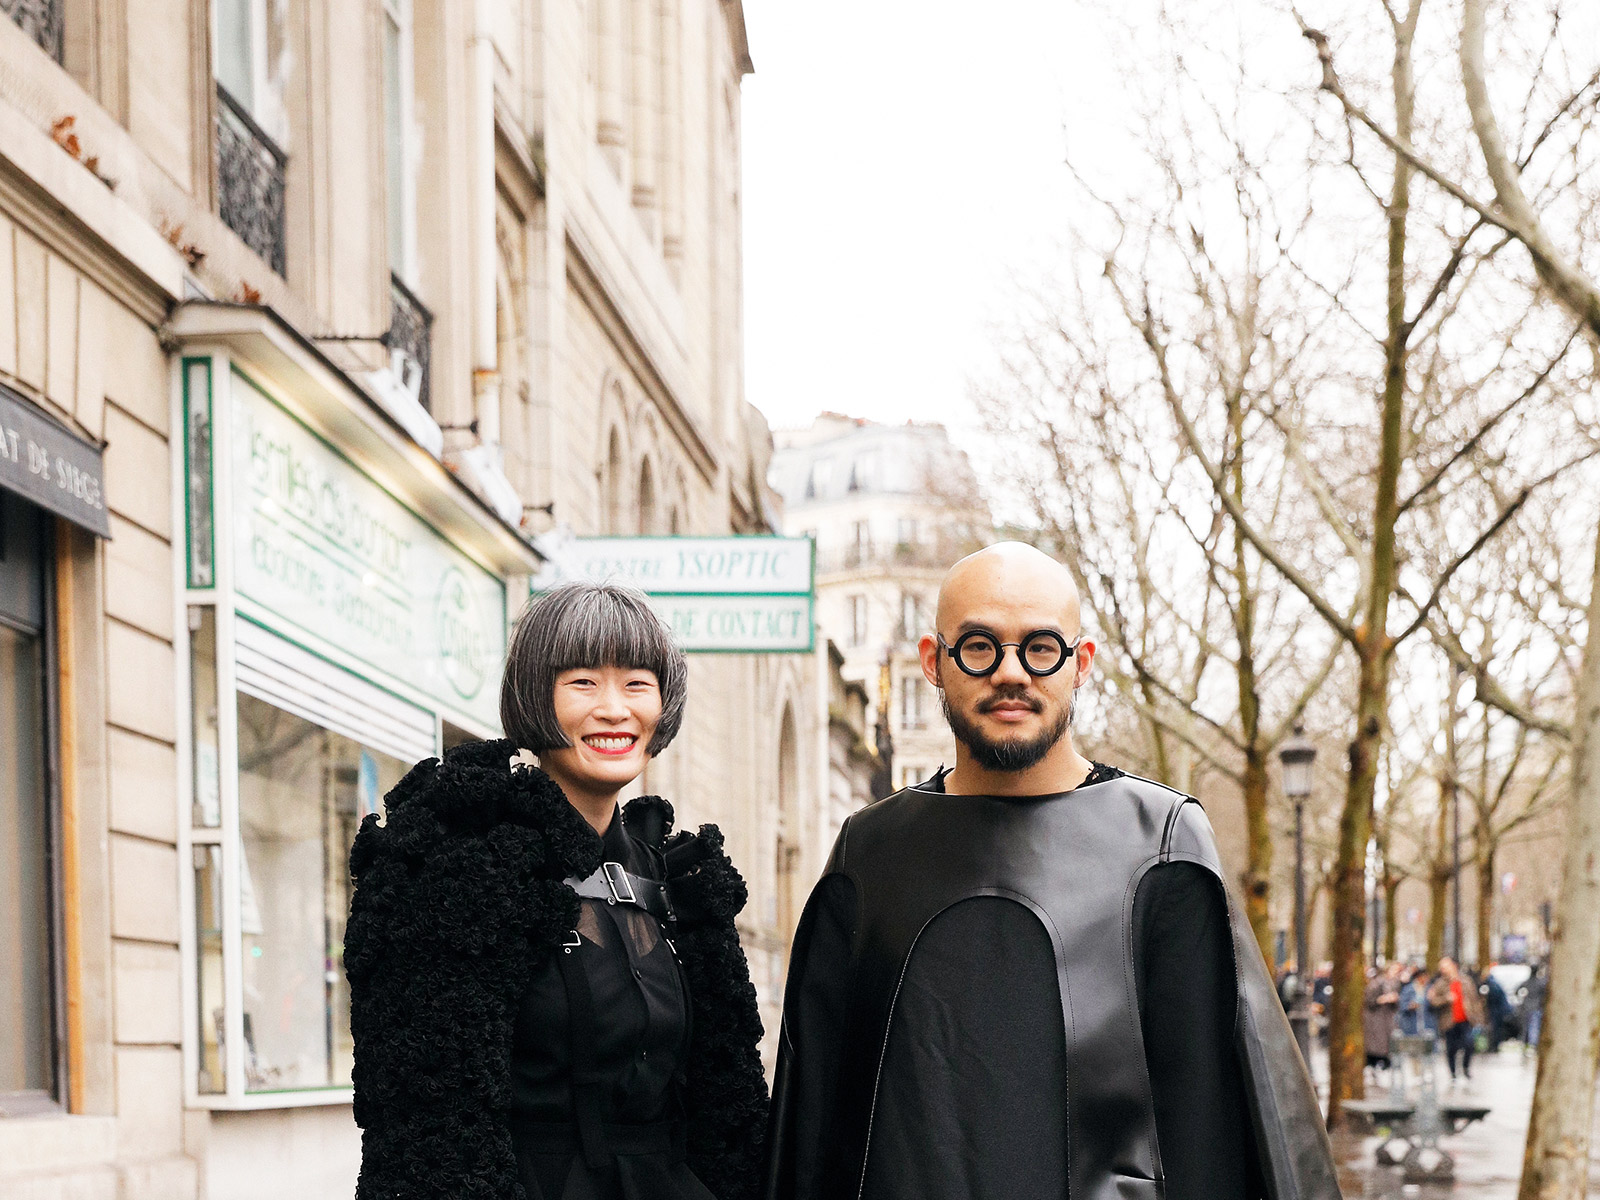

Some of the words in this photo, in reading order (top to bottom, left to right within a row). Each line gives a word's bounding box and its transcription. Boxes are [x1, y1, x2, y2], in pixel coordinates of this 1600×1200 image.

[27, 440, 51, 480] DE
[584, 558, 663, 578] CENTRE
[677, 550, 791, 578] YSOPTIC
[672, 608, 702, 638] DE
[706, 608, 802, 638] CONTACT
